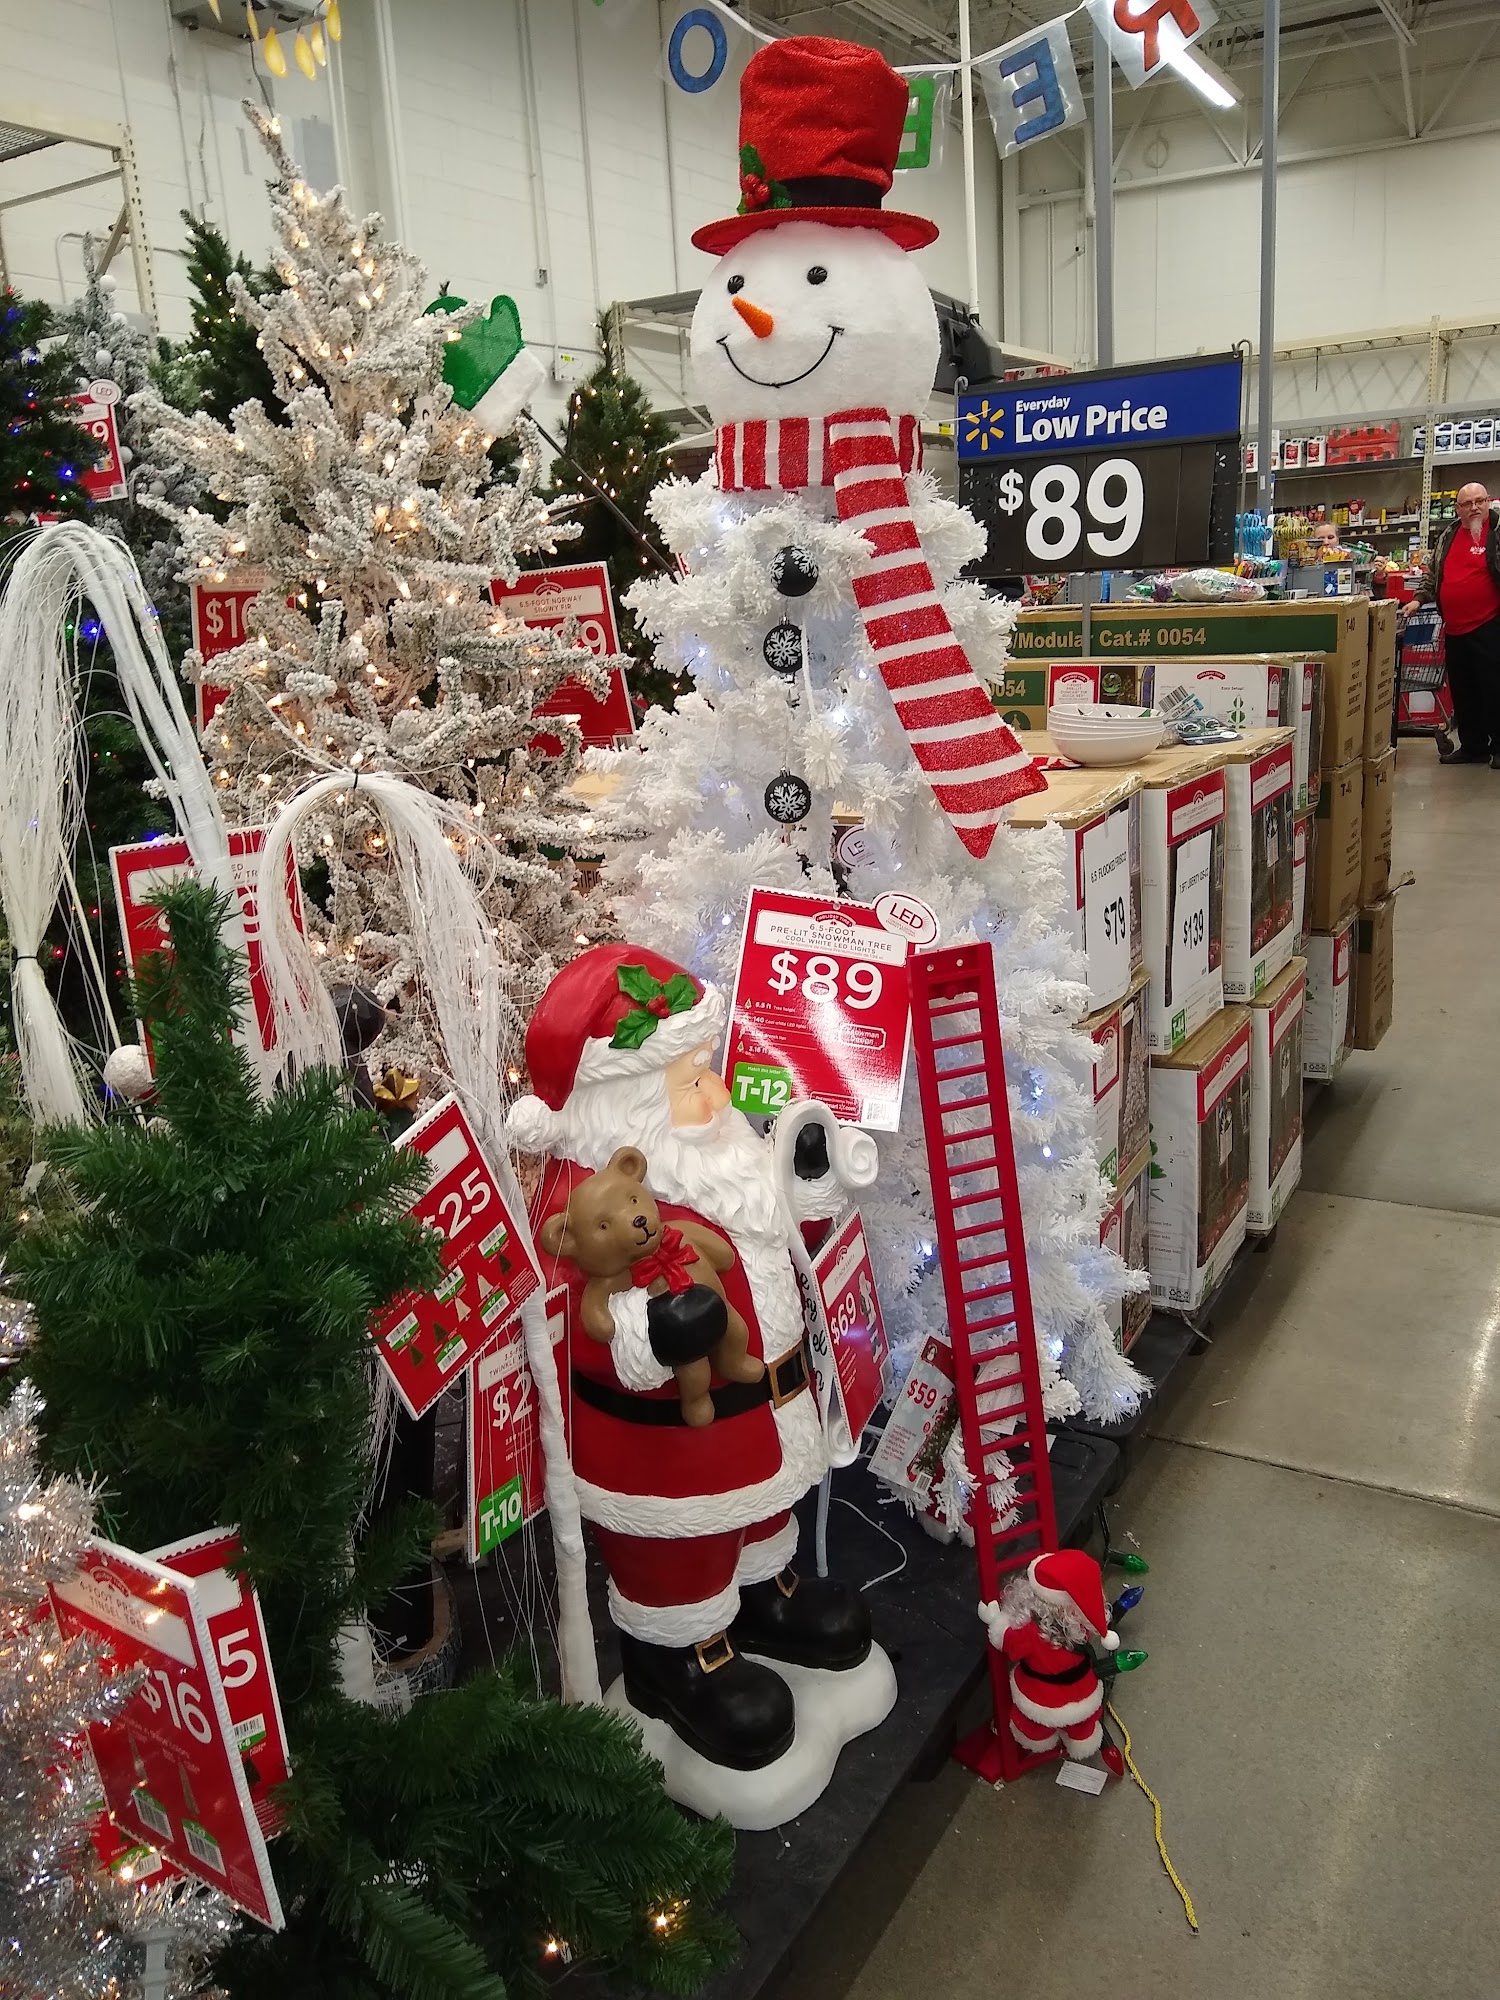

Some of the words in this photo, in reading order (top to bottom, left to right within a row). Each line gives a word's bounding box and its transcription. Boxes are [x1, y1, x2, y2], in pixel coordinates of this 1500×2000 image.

[668, 8, 728, 94] O
[1016, 396, 1071, 413] Everyday
[1015, 414, 1080, 443] Low
[1086, 400, 1168, 436] Price
[999, 459, 1144, 561] $89
[520, 597, 550, 608] 6.5-FOOT
[551, 594, 582, 604] NORWAY
[534, 605, 559, 613] SNOWY
[1100, 629, 1150, 648] Cat.#
[1157, 627, 1207, 646] 0054
[810, 923, 856, 937] 6.5-FOOT
[890, 902, 923, 928] LED
[1103, 897, 1126, 945] $79
[1183, 908, 1204, 950] $139
[771, 925, 808, 937] PRE-LIT
[812, 931, 864, 946] SNOWMAN
[868, 940, 892, 951] TREE
[785, 935, 806, 943] COOL
[808, 938, 832, 947] WHITE
[850, 945, 876, 954] LIGHTS
[767, 950, 883, 1010] $89
[755, 1001, 766, 1009] 6.5
[735, 1075, 788, 1106] T-12
[447, 1258, 458, 1271] ese
[457, 1241, 476, 1260] colors:
[830, 1291, 857, 1345] $69
[489, 1357, 515, 1378] TWINKLE
[492, 1371, 533, 1431] $2
[907, 1379, 937, 1410] $59
[480, 1491, 522, 1542] T-10
